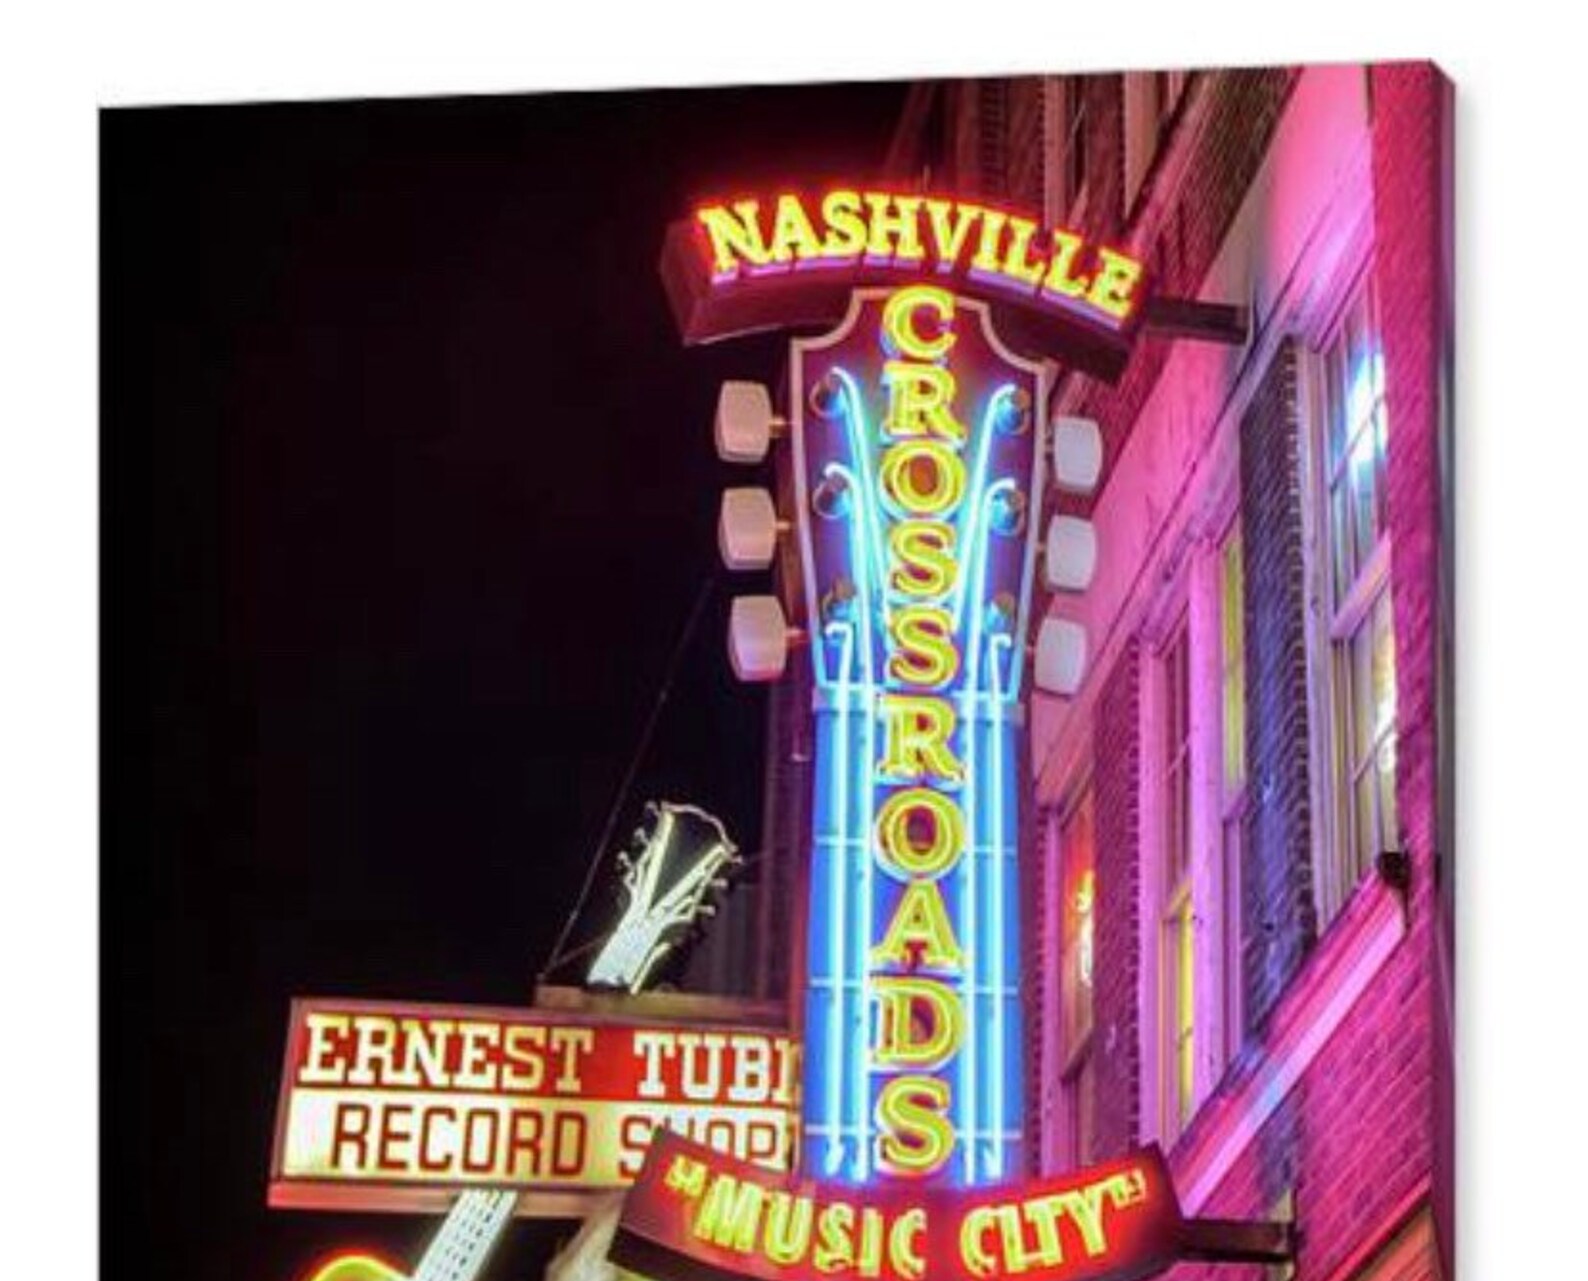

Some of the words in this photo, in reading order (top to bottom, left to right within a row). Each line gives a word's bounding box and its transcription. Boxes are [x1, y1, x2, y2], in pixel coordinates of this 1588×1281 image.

[699, 191, 1142, 330] NASHVILLE
[870, 285, 967, 1175] CROSSROADS
[300, 1013, 593, 1093] ERNEST
[331, 1102, 588, 1178] RECORD
